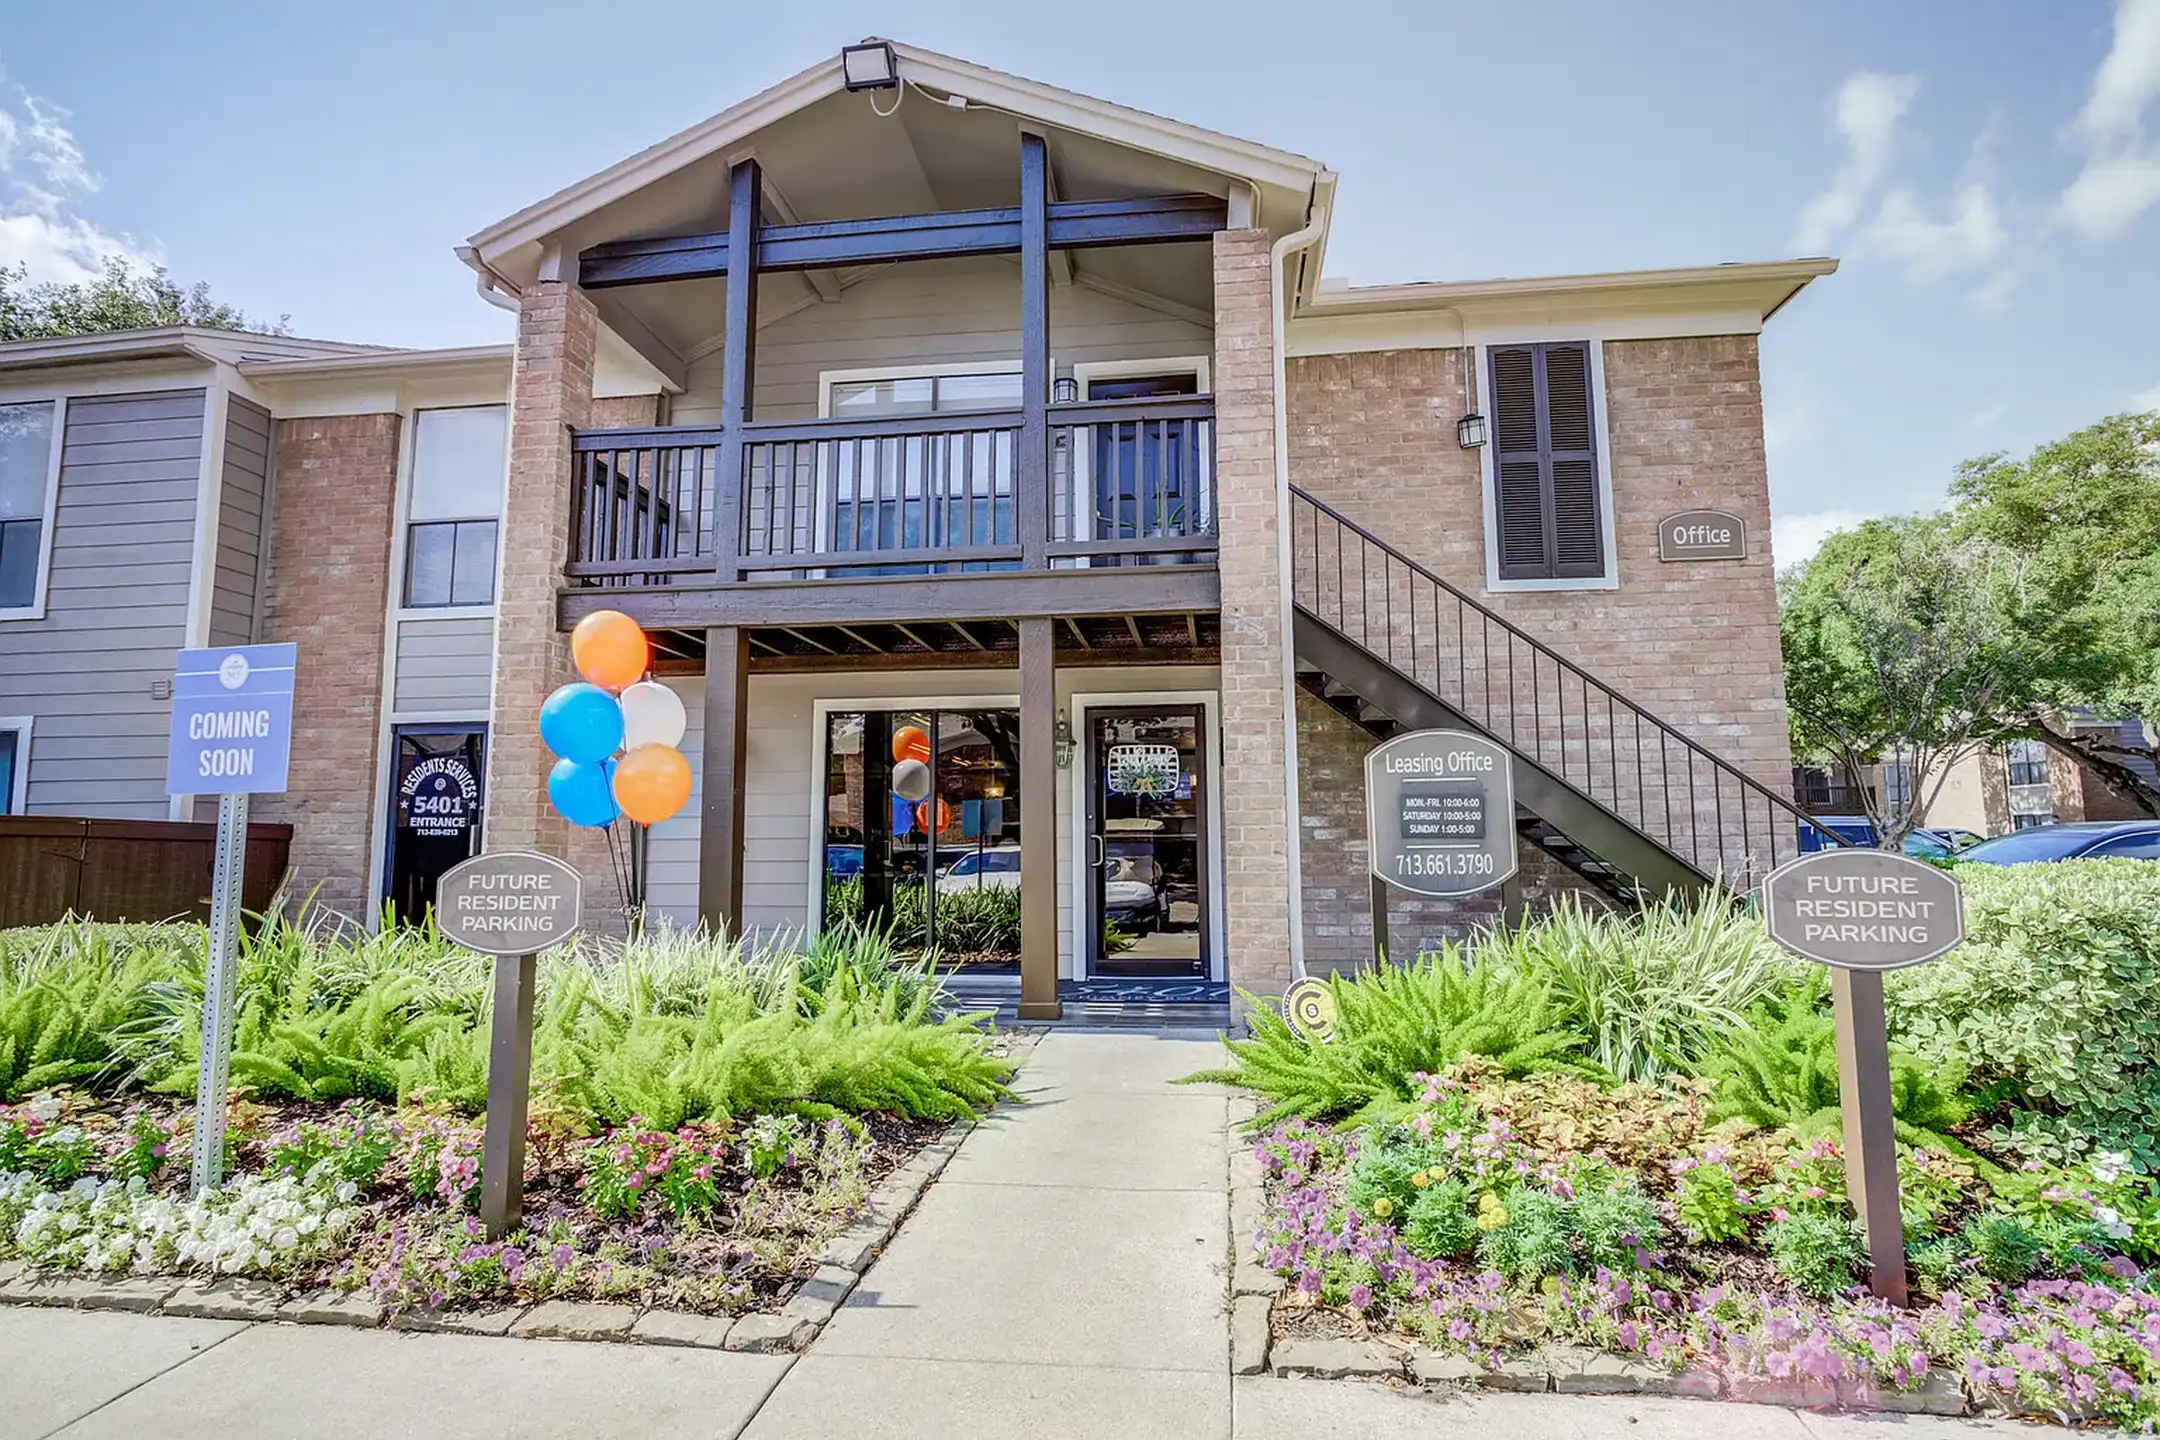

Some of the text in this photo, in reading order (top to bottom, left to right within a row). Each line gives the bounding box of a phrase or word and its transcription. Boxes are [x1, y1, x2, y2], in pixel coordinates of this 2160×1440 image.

[1673, 525, 1731, 544] Office
[189, 710, 270, 740] COMING
[199, 748, 254, 777] SOON
[1386, 751, 1493, 775] Leasing Office
[400, 757, 477, 799] RESIDENTS SERVICES
[414, 796, 463, 814] 5401
[409, 817, 466, 828] ENTRANCE
[1402, 811, 1442, 821] SATURDAY
[1409, 824, 1475, 834] SUNDAY 1:00-5:00
[1396, 853, 1493, 876] 713.661.3790
[469, 874, 552, 889] FUTURE
[1807, 875, 1919, 894] FUTURE
[457, 895, 561, 910] RESIDENT
[1795, 899, 1935, 919] RESIDENT
[462, 916, 553, 931] PARKING
[1804, 924, 1929, 943] PARKING
